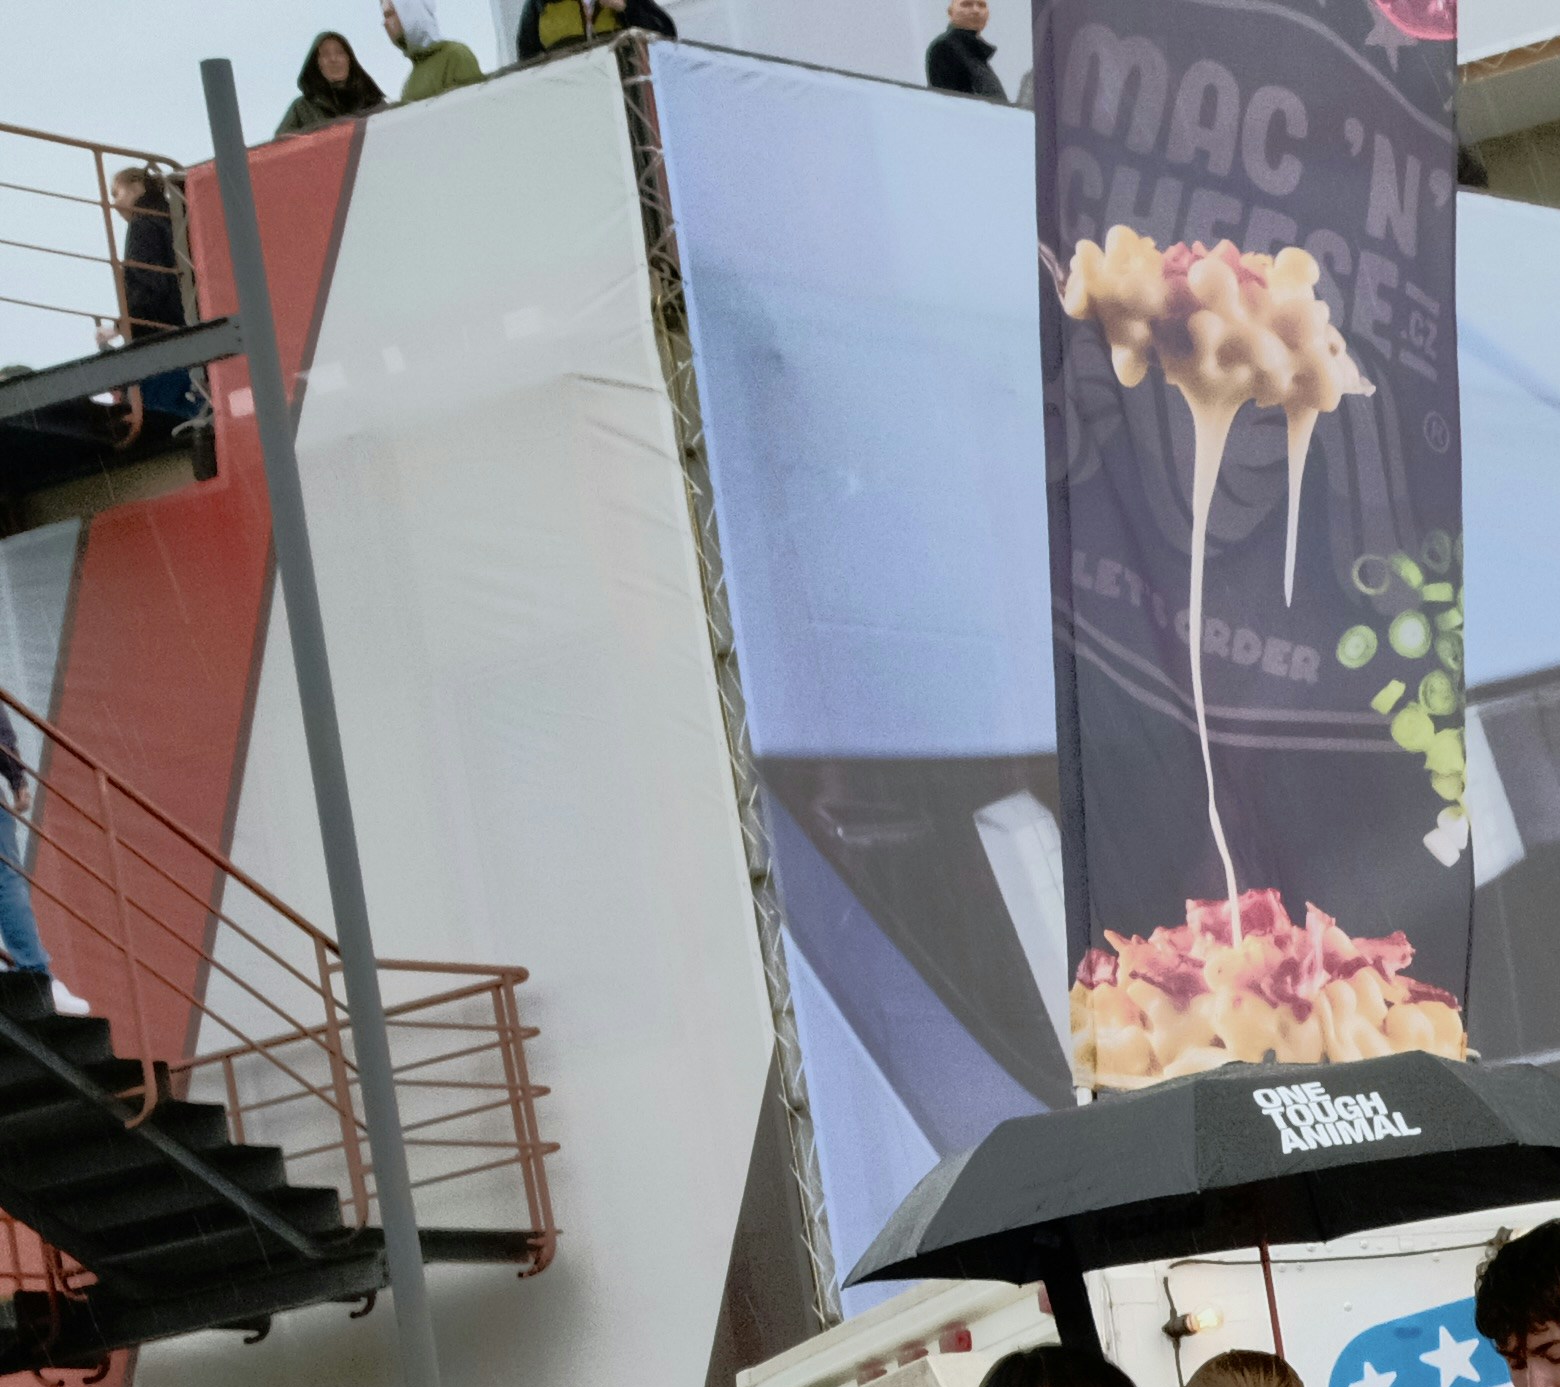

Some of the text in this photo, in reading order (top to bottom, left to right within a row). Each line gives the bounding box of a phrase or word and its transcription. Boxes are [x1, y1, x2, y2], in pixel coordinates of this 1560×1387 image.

[1060, 23, 1308, 197] MAC
[1174, 607, 1321, 685] ORDER
[1252, 1081, 1331, 1110] ONE
[1261, 1091, 1389, 1131] TOUGH
[1280, 1111, 1422, 1155] ANIMAL
